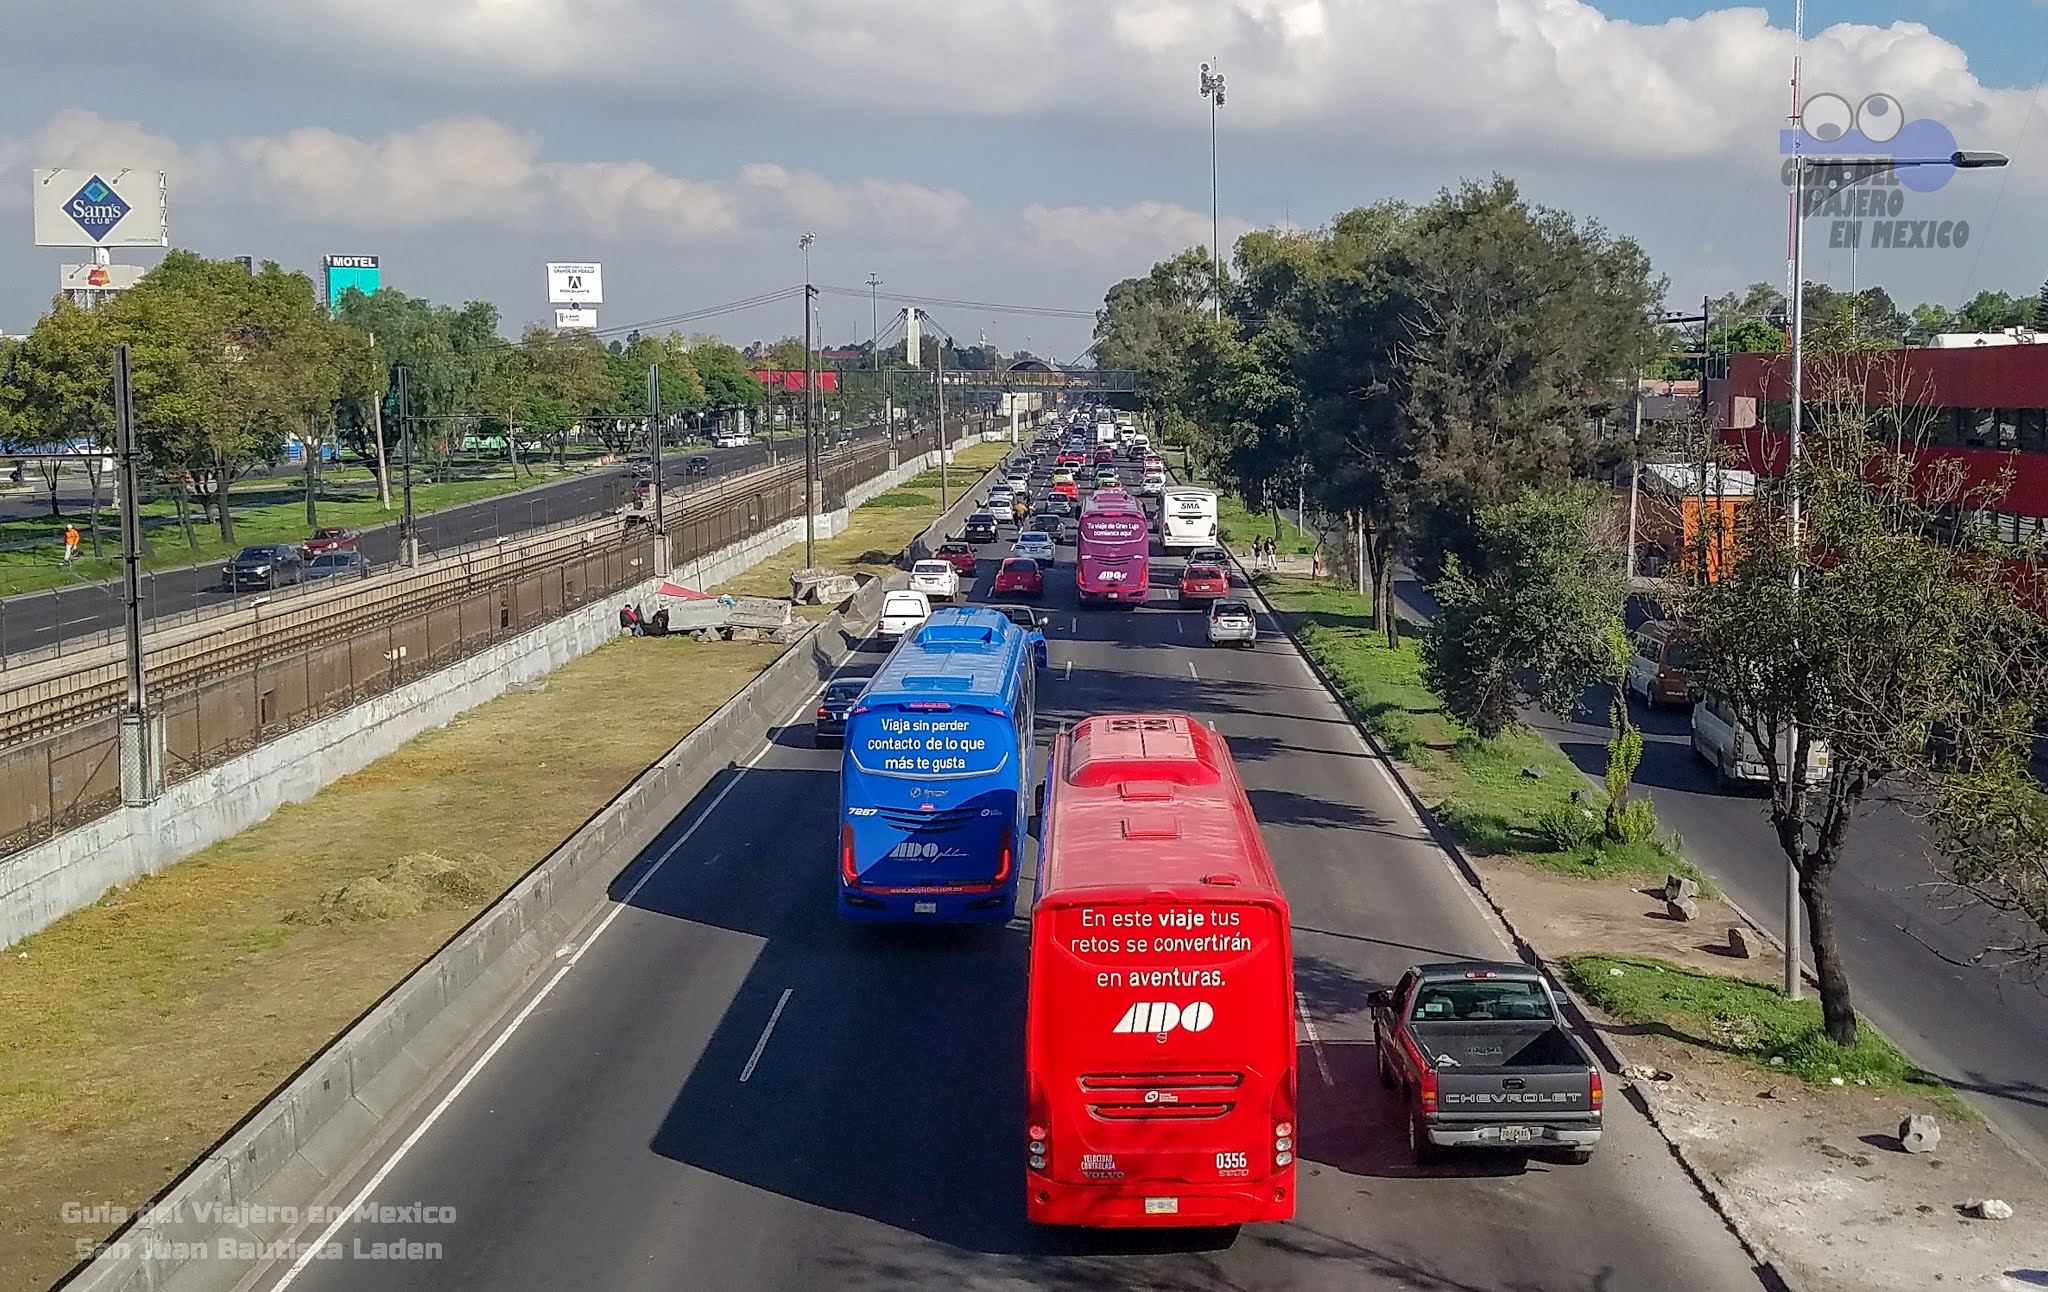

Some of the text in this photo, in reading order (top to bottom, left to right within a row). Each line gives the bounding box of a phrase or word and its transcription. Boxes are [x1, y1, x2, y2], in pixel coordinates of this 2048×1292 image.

[72, 199, 121, 218] Sam's
[333, 256, 376, 268] MOTEL
[881, 718, 969, 734] Viaja sin perder
[868, 737, 985, 752] contacto de lo que
[885, 756, 966, 772] más te gusta
[889, 842, 939, 858] ADO
[1082, 909, 1240, 930] En este viaje tus
[1071, 931, 1251, 953] retos se convertirán
[1097, 967, 1226, 987] en aventuras.
[1112, 1001, 1214, 1033] ADO
[1445, 1093, 1582, 1103] CHEVROLET
[1216, 1152, 1247, 1169] 0356
[1083, 1171, 1125, 1179] VOLVO
